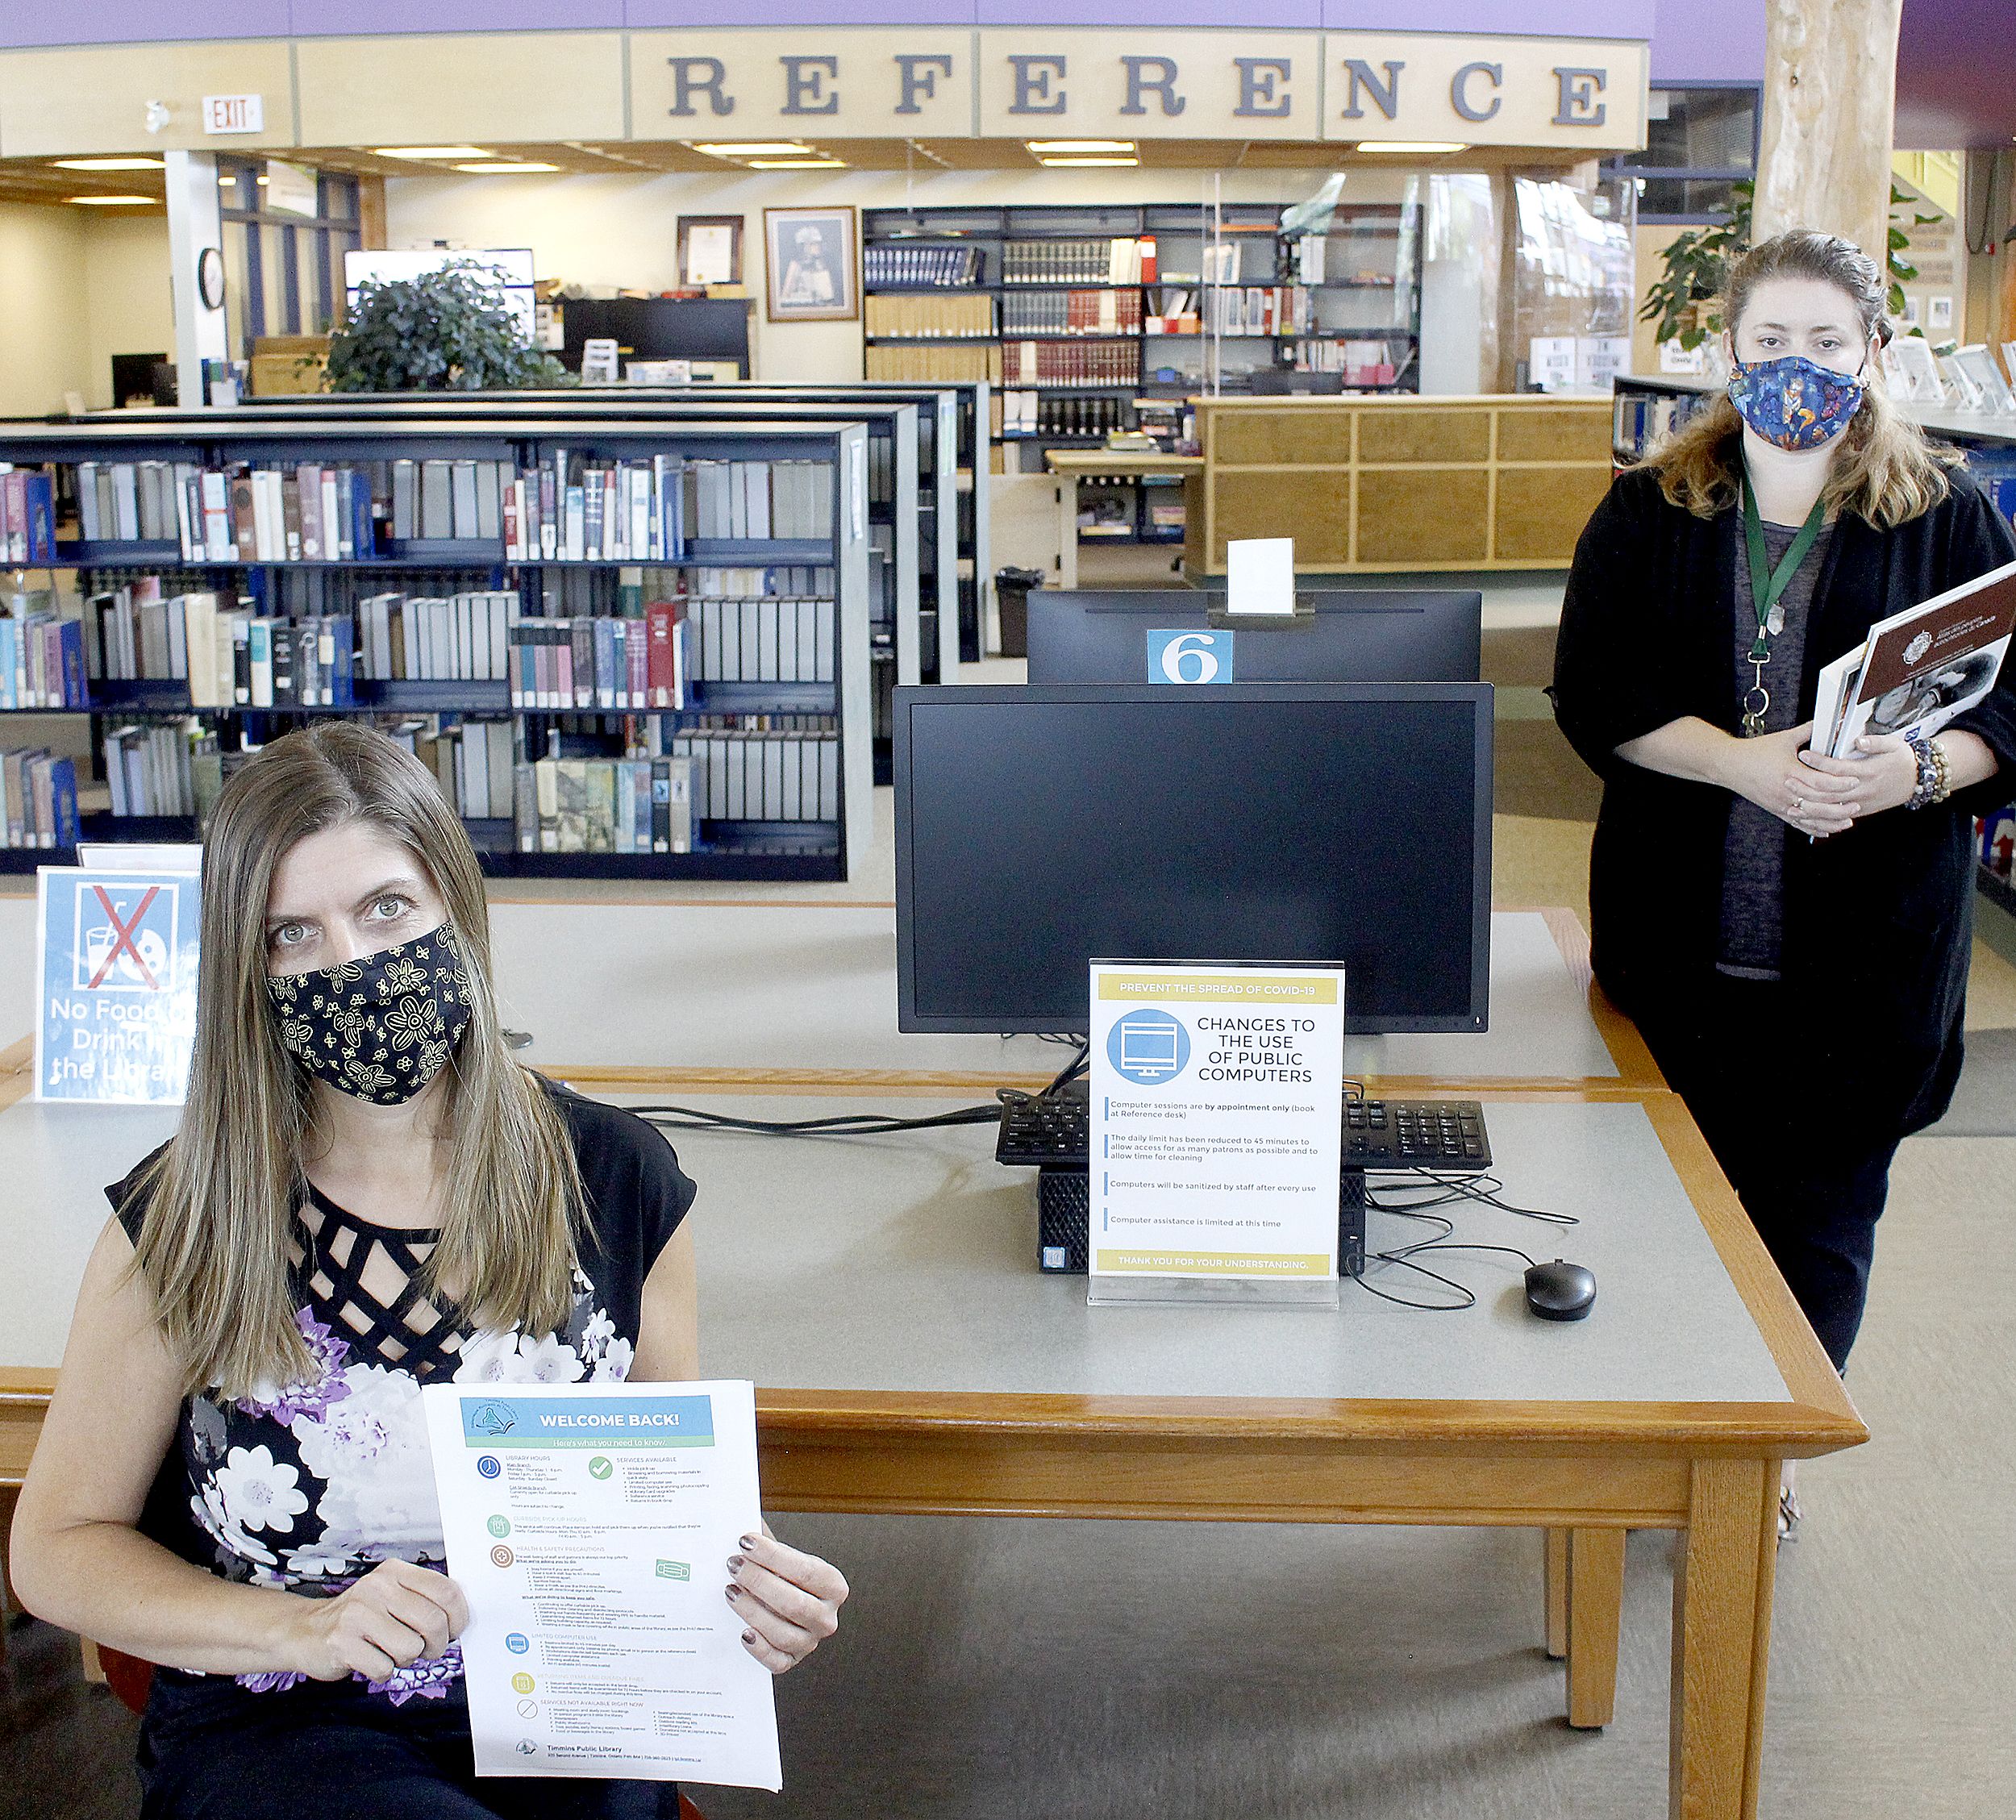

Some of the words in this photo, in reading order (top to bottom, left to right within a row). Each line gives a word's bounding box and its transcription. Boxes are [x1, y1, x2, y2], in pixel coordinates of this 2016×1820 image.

[668, 53, 1607, 127] REFERENCE
[214, 99, 249, 128] EXIT
[1160, 633, 1218, 684] 6
[1120, 983, 1172, 993] PREVENT
[1174, 984, 1195, 993] THE
[1198, 985, 1243, 994] SPREAD
[1246, 985, 1262, 994] OF
[1264, 986, 1315, 995] COVID-19
[52, 998, 86, 1019] No
[96, 999, 159, 1021] Food
[1198, 1018, 1285, 1031] CHANGES
[1292, 1020, 1314, 1032] TO
[73, 1028, 142, 1050] Drink
[1218, 1035, 1252, 1047] THE
[1259, 1035, 1293, 1048] USE
[1209, 1052, 1233, 1064] OF
[1239, 1052, 1302, 1065] PUBLIC
[52, 1057, 94, 1079] the
[1198, 1068, 1312, 1082] COMPUTERS
[1110, 1101, 1152, 1110] Computer
[1205, 1103, 1214, 1112] by
[1217, 1104, 1269, 1114] appointment
[1272, 1104, 1289, 1114] only
[1292, 1104, 1314, 1114] (book
[1164, 1110, 1186, 1119] desk)
[1110, 1134, 1125, 1142] The
[1127, 1135, 1147, 1144] daily
[1169, 1135, 1183, 1143] has
[1188, 1147, 1210, 1155] many
[1213, 1147, 1243, 1156] patrons
[1256, 1147, 1289, 1156] possible
[1168, 1154, 1202, 1163] cleaning
[1110, 1180, 1155, 1189] Computers
[1173, 1181, 1183, 1189] be
[1185, 1182, 1222, 1190] sanitized
[1224, 1183, 1234, 1192] by
[1235, 1183, 1254, 1191] staff
[1277, 1185, 1299, 1193] every
[1110, 1216, 1151, 1226] Computer
[1118, 1256, 1151, 1264] THANK
[1153, 1257, 1173, 1266] YOU
[1175, 1258, 1194, 1266] FOR
[1197, 1258, 1223, 1267] YOUR
[1225, 1259, 1308, 1269] UNDERSTANDING.
[539, 1414, 625, 1426] WELCOME
[628, 1414, 680, 1426] BACK!
